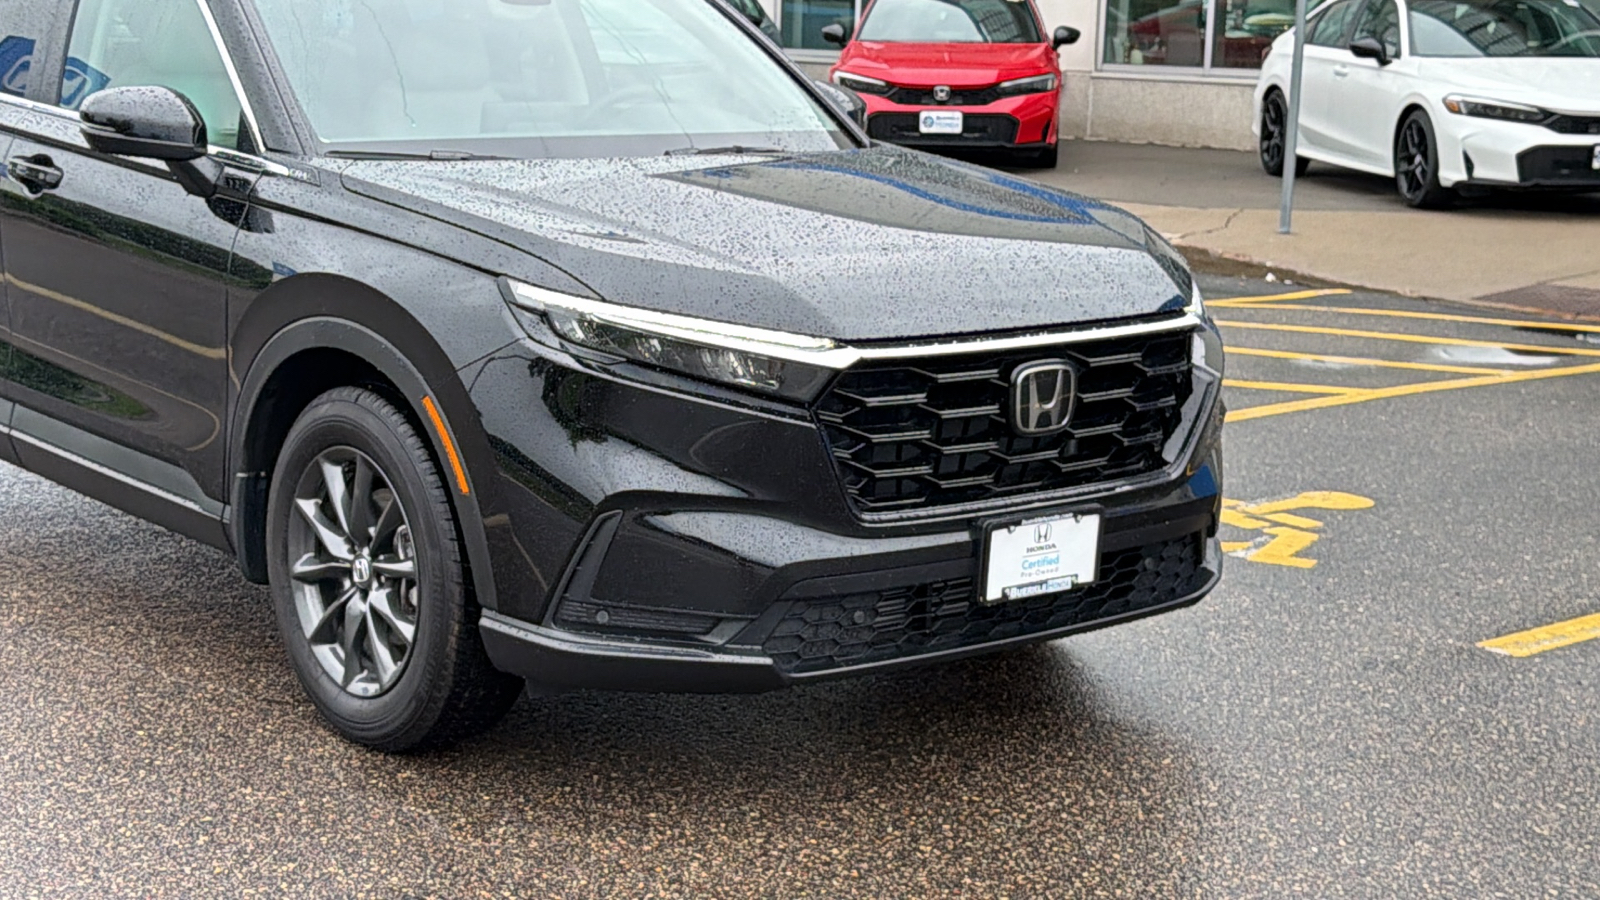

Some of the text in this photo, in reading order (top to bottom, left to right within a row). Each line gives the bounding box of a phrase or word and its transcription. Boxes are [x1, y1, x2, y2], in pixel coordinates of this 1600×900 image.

[1026, 543, 1057, 553] HONDA
[1021, 554, 1060, 570] Certified
[1020, 567, 1060, 578] Pre-Owned
